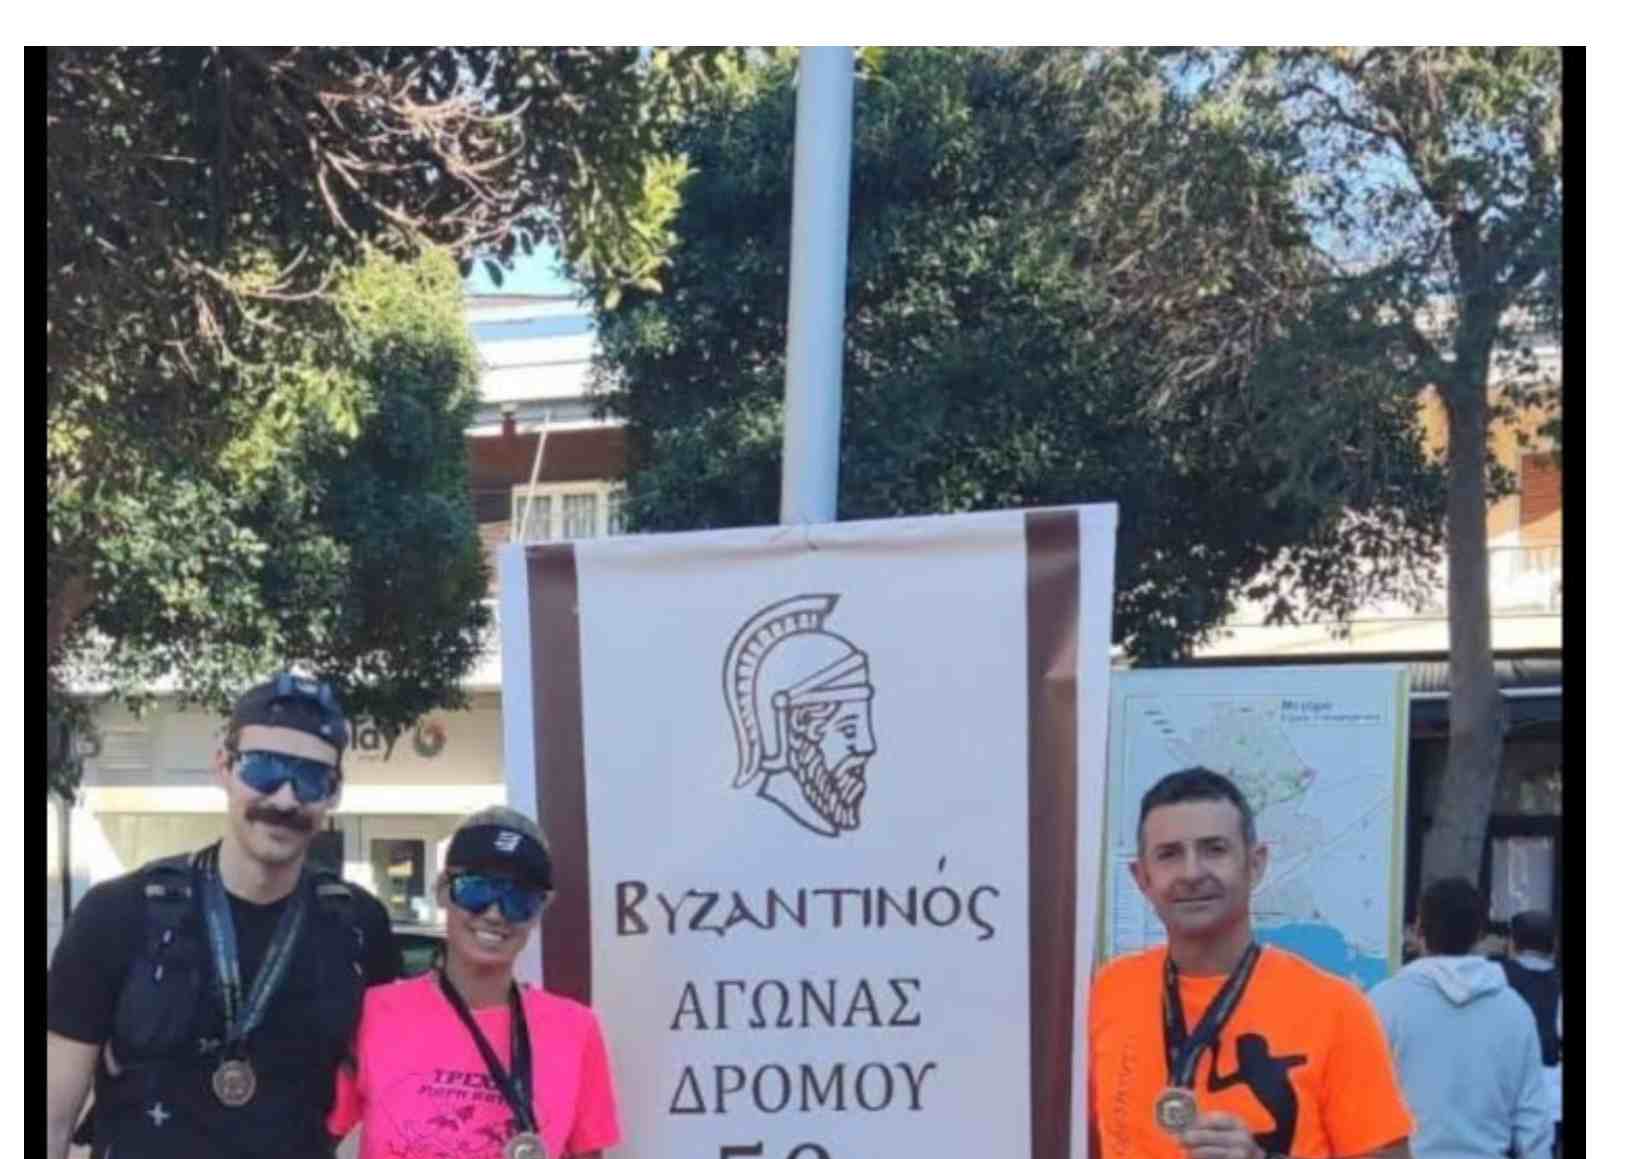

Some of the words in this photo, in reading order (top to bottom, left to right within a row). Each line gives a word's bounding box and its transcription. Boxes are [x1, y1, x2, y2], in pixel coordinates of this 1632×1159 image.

[351, 716, 402, 762] lay
[668, 976, 922, 1031] ΑΓΩΝΑΣ
[667, 1060, 938, 1115] ΔΡΟΜΟΥ
